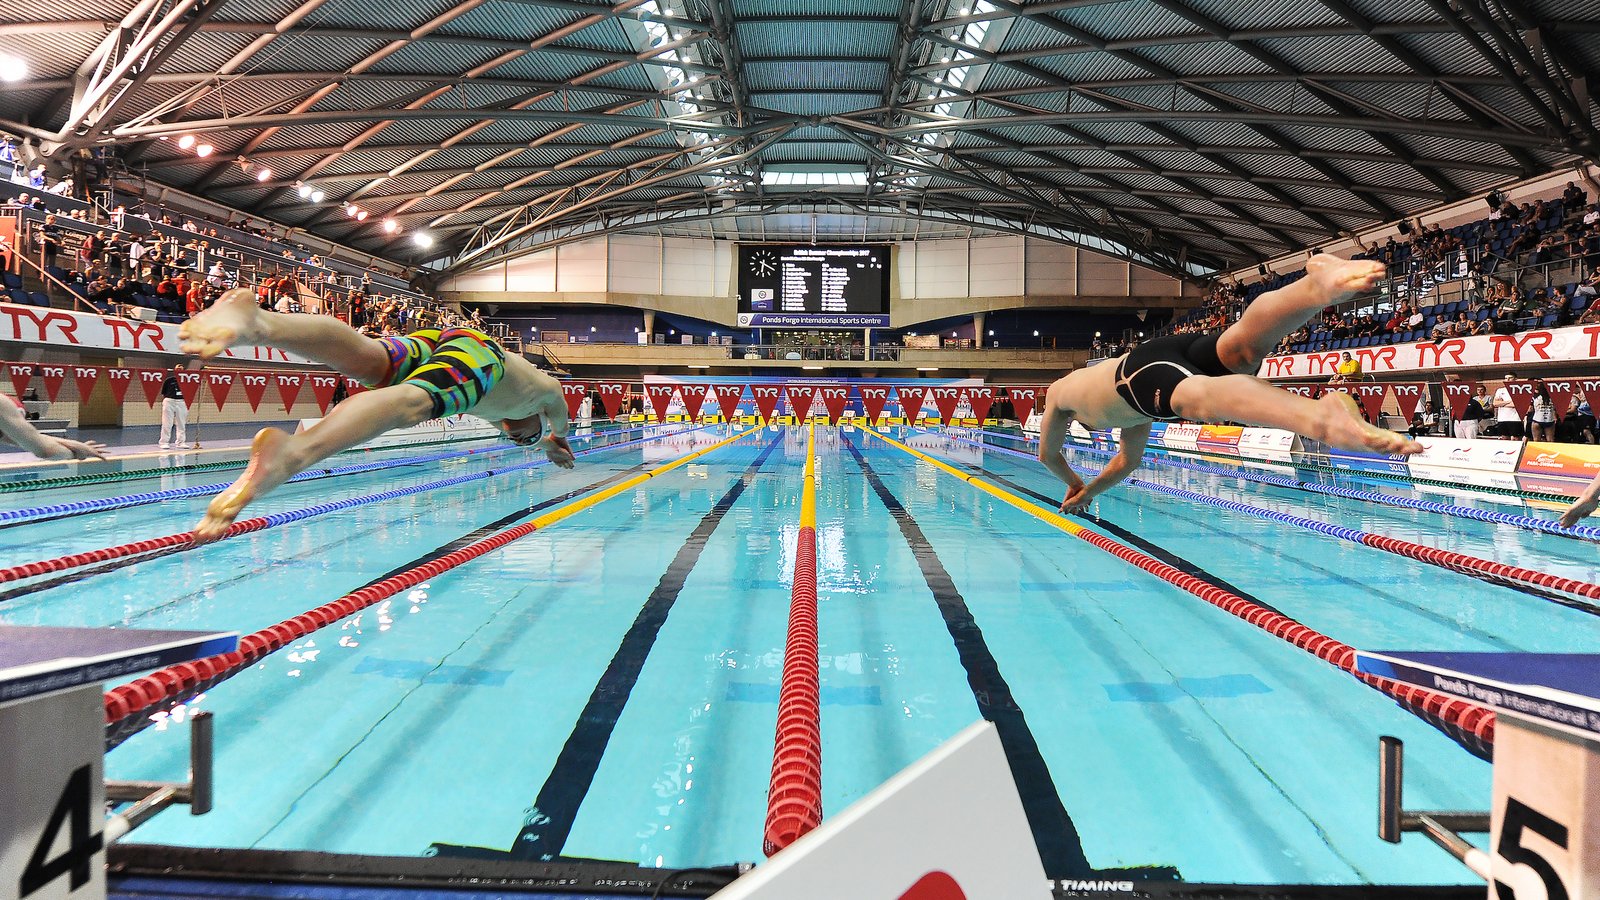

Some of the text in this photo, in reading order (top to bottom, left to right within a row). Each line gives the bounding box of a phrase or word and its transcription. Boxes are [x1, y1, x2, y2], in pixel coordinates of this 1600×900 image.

[1, 306, 80, 344] TYR
[782, 316, 800, 325] Forge
[800, 316, 839, 324] International
[839, 317, 860, 325] Sports
[103, 318, 166, 351] TYR
[1488, 331, 1552, 363] TYR
[1356, 346, 1397, 371] TYR
[1415, 339, 1466, 367] TYR
[1266, 356, 1294, 377] TYR
[1307, 352, 1340, 375] TYR
[11, 365, 32, 376] TYR
[43, 367, 64, 378] TYR
[75, 368, 97, 379] TYR
[109, 369, 131, 380] TYR
[141, 371, 163, 382] TYR
[178, 372, 200, 383] TYR
[210, 374, 232, 385] TYR
[244, 375, 267, 386] TYR
[277, 376, 300, 386] TYR
[313, 377, 336, 388] TYR
[347, 378, 360, 388] TY
[1547, 382, 1571, 393] TYR
[1583, 380, 1600, 392] TY
[562, 384, 585, 395] TYR
[600, 384, 623, 395] TYR
[650, 386, 673, 396] TYR
[682, 386, 705, 396] TYR
[717, 386, 740, 397] TYR
[755, 387, 778, 398] TYR
[788, 387, 812, 397] TYR
[824, 388, 847, 399] TYR
[863, 388, 886, 399] TYR
[900, 388, 923, 398] TYR
[934, 388, 958, 399] TYR
[968, 388, 992, 398] TYR
[1011, 389, 1035, 400] TYR
[1287, 387, 1311, 397] TYR
[1359, 386, 1383, 396] TYR
[1395, 385, 1419, 396] TYR
[1446, 384, 1470, 395] TYR
[1509, 384, 1533, 394] TYR
[1388, 453, 1405, 461] 2017
[1433, 674, 1469, 696] Ponds
[1467, 683, 1503, 706] Forge
[1502, 692, 1589, 728] International
[19, 763, 104, 899] 4
[1491, 796, 1570, 900] 5
[1060, 880, 1134, 892] TIMING
